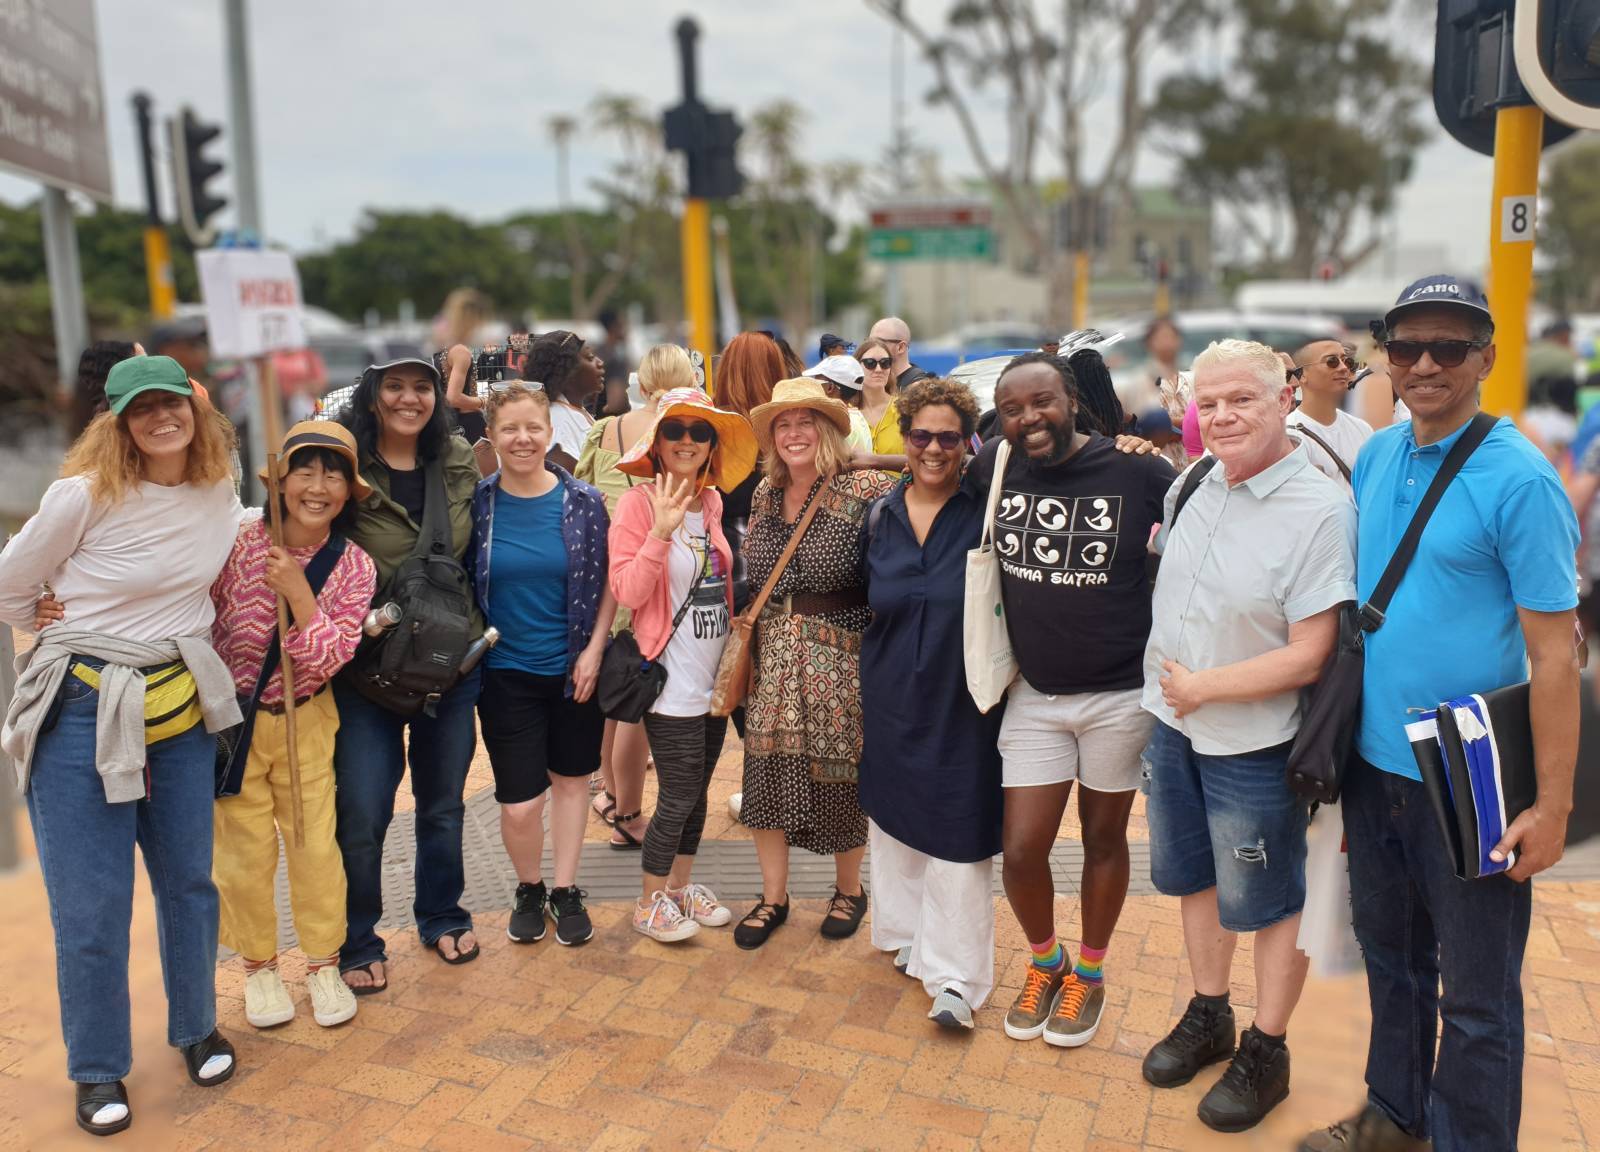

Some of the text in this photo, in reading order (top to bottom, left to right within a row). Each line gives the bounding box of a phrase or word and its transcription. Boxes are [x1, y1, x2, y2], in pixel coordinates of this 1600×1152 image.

[1511, 202, 1528, 233] 8
[1407, 283, 1462, 300] Cano
[1000, 558, 1108, 588] OMMA SUTRA
[692, 608, 730, 640] OFFLIN
